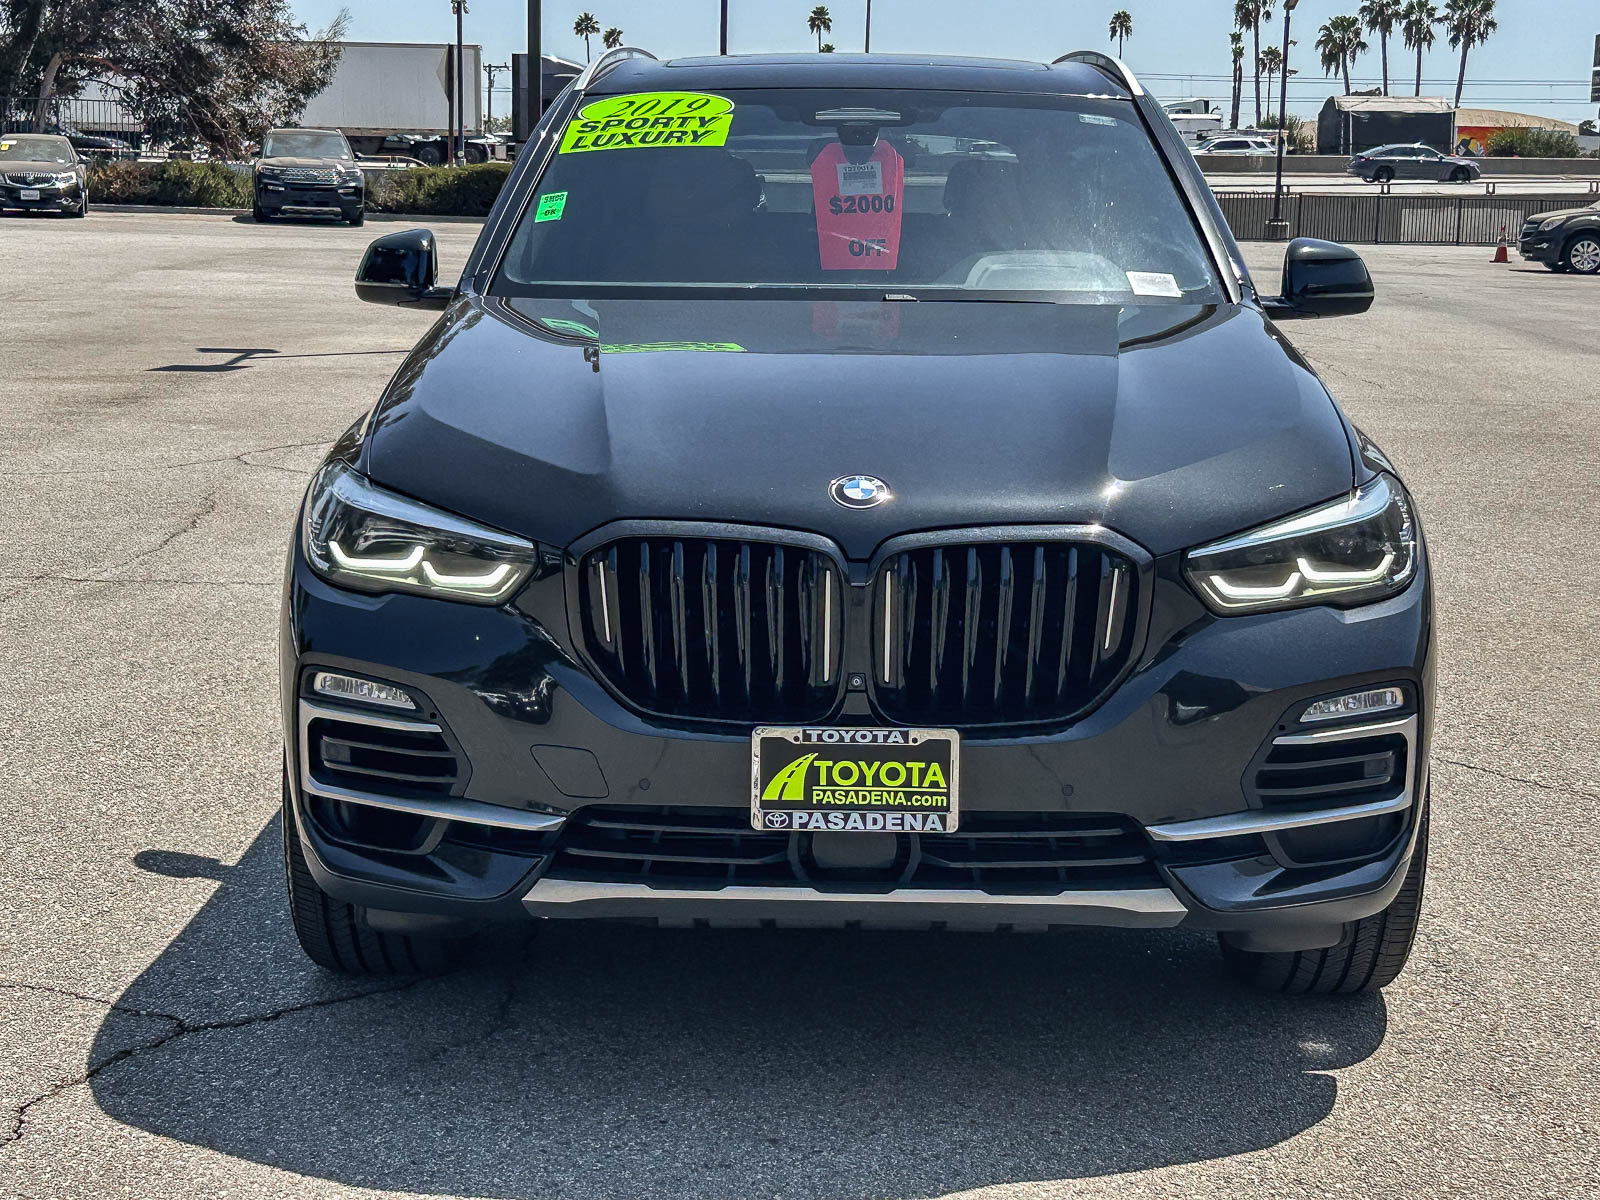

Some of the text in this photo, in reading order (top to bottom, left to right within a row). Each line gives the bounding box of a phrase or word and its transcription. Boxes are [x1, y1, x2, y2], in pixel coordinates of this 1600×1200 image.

[602, 97, 711, 119] 2019
[576, 116, 722, 134] SPORTY
[570, 130, 717, 150] LUXURY
[828, 195, 895, 216] $2000
[848, 238, 887, 257] OFF
[806, 729, 905, 744] TOYOTA
[813, 760, 948, 788] TOYOTA
[812, 790, 948, 807] PASADENA.com
[792, 812, 944, 831] PASADENA
